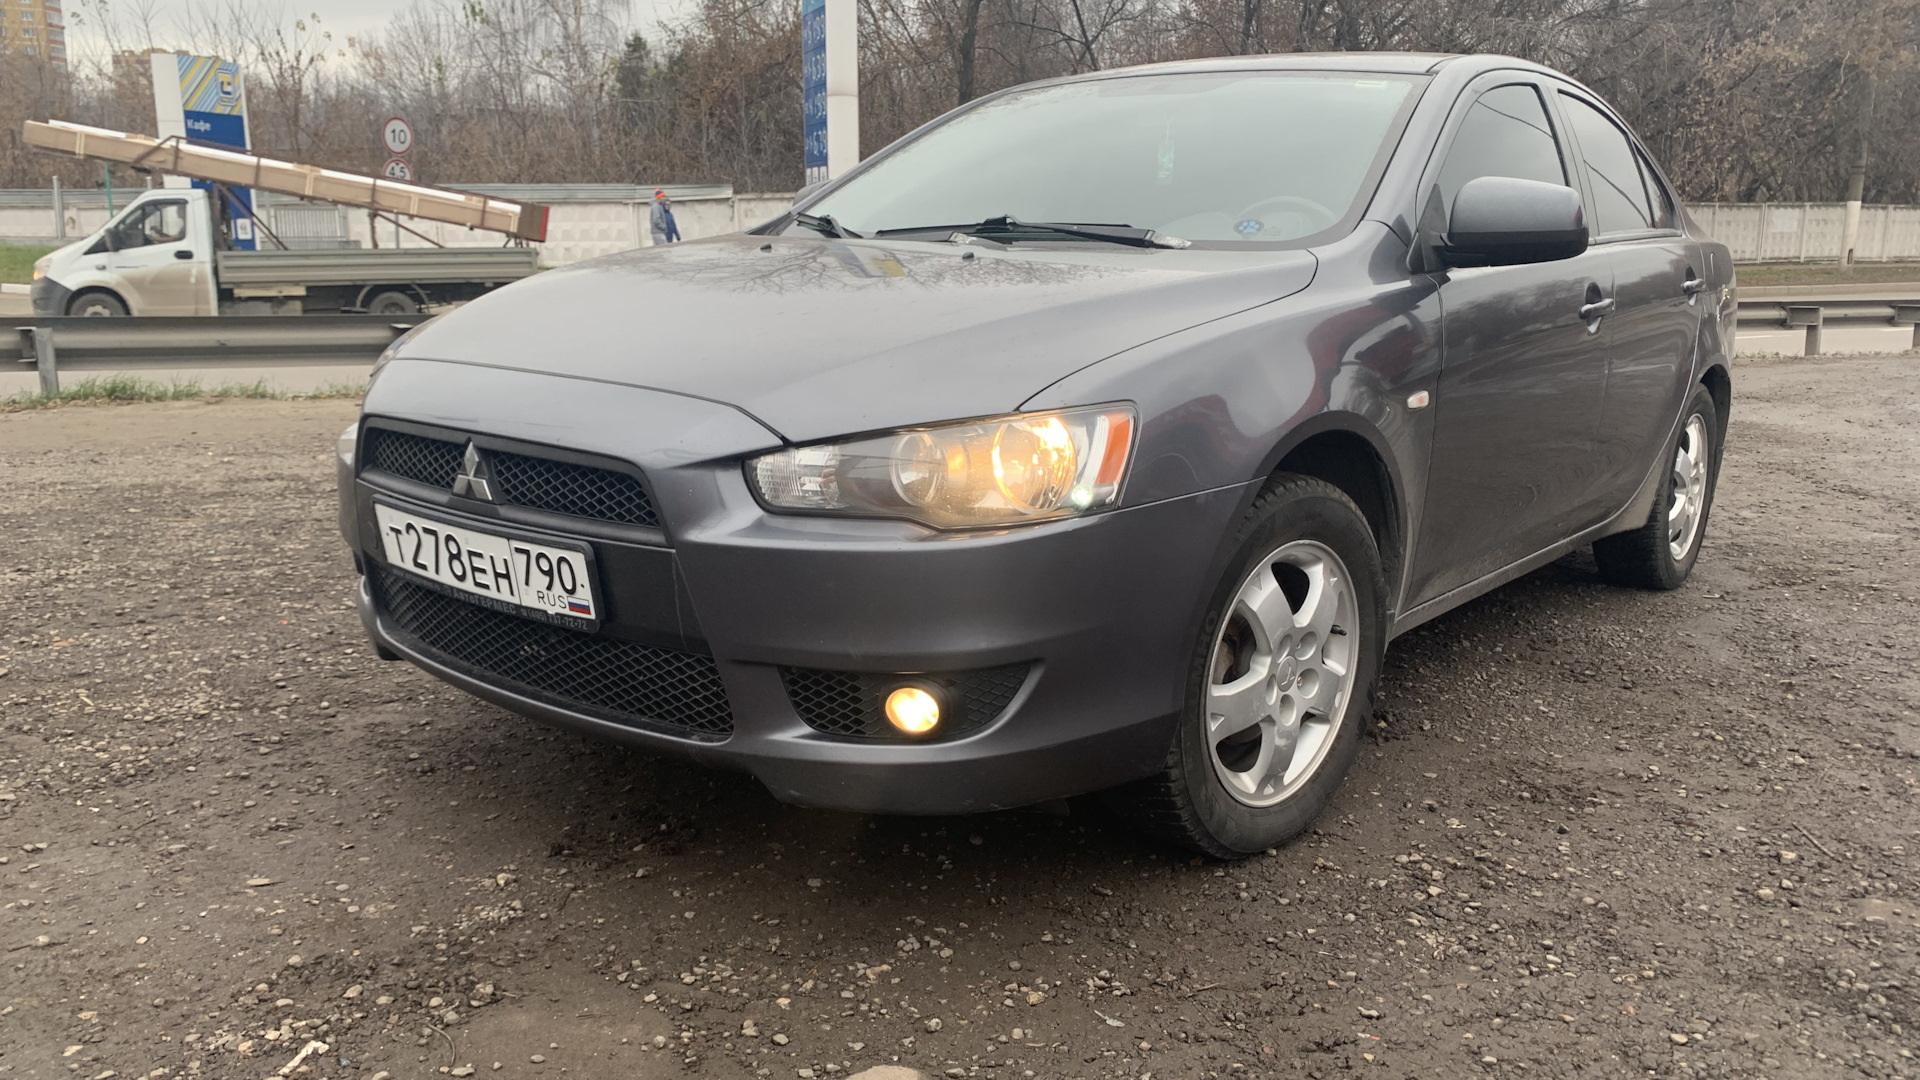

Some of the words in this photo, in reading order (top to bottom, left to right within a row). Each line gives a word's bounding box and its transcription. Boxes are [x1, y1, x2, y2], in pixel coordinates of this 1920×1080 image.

[186, 119, 212, 132] Кафе
[391, 128, 407, 145] 10
[514, 547, 577, 595] 790
[536, 590, 567, 609] RUS
